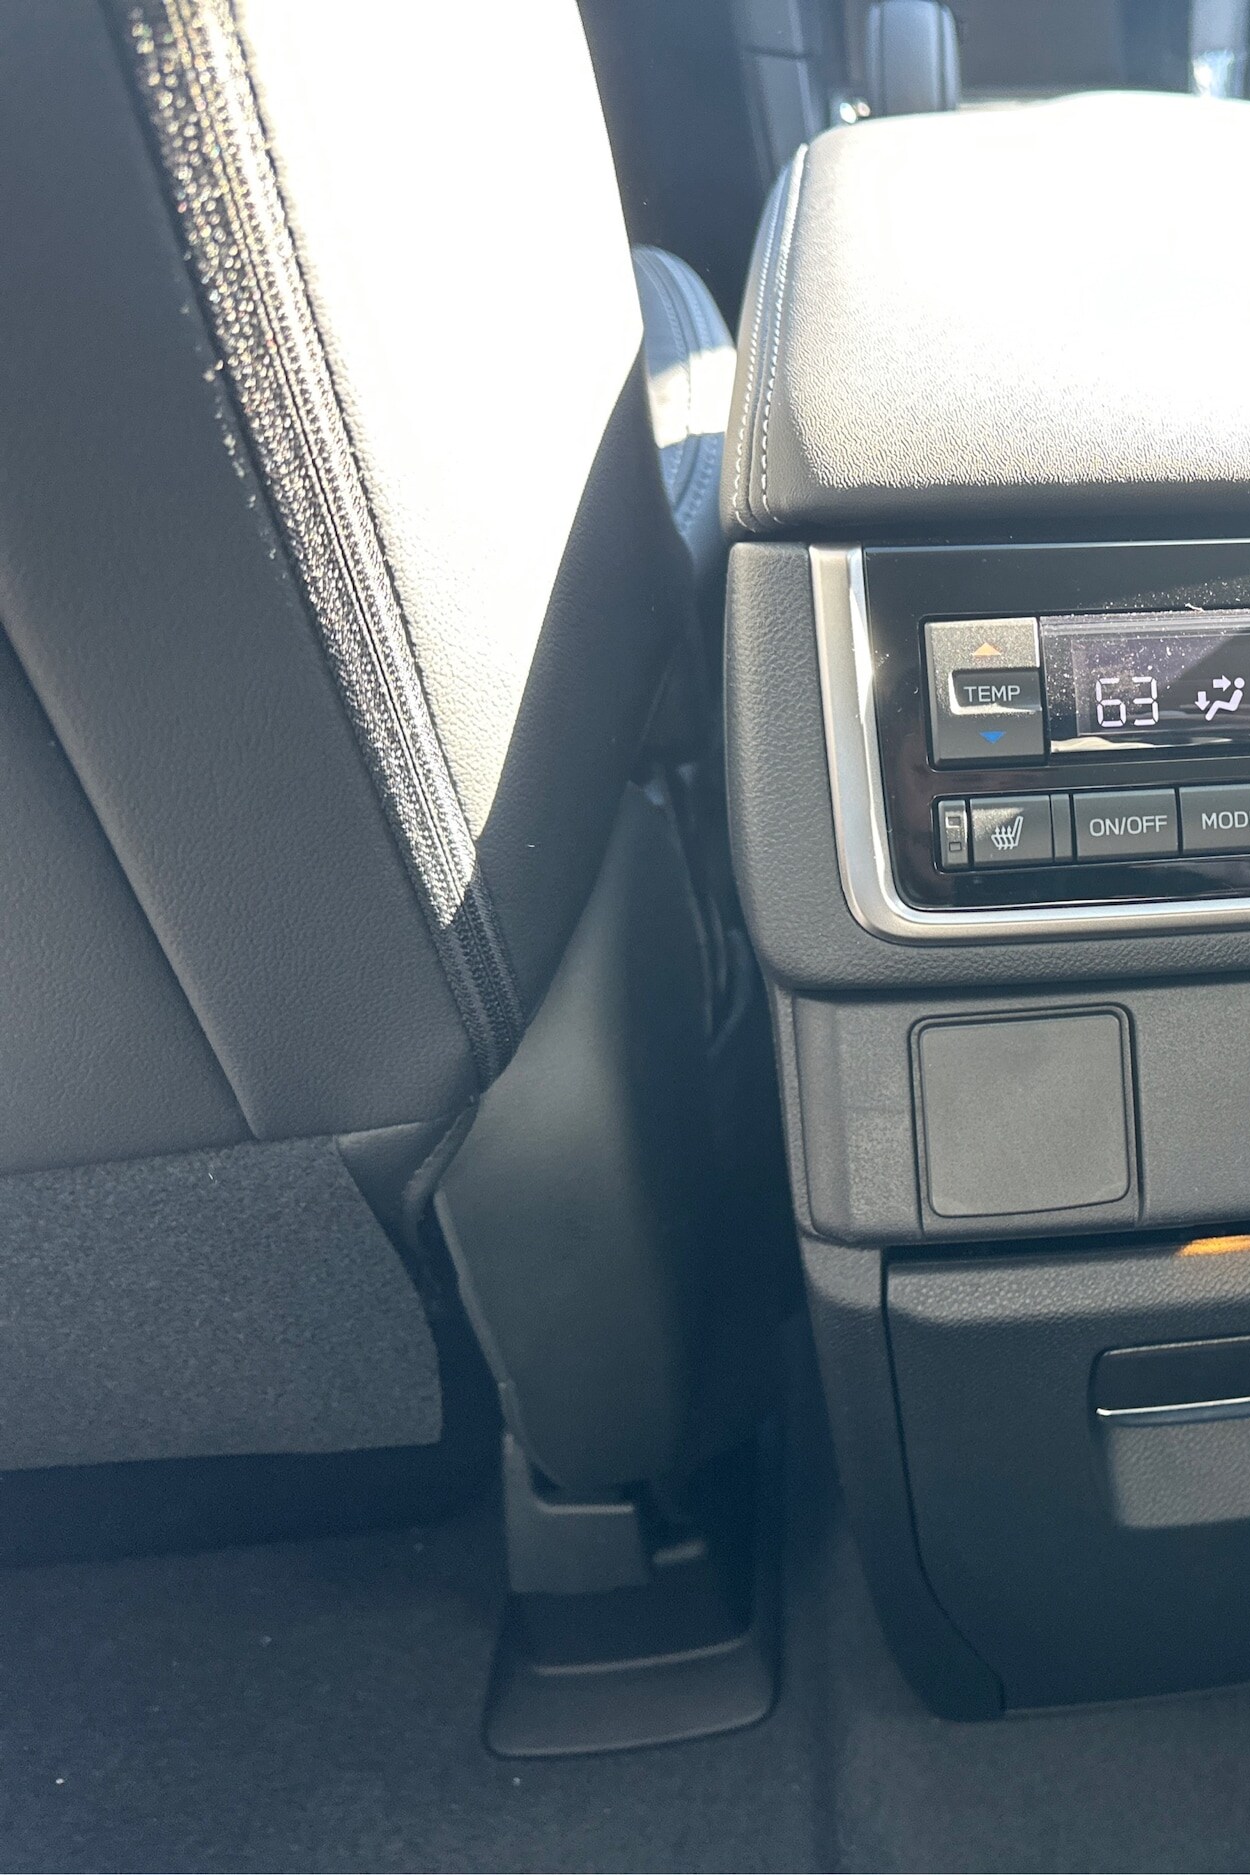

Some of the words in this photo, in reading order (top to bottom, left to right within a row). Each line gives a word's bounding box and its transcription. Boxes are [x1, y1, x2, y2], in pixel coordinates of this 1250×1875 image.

[963, 684, 1021, 704] TEMP
[1095, 675, 1159, 728] 63
[1088, 813, 1169, 838] ON/OFF
